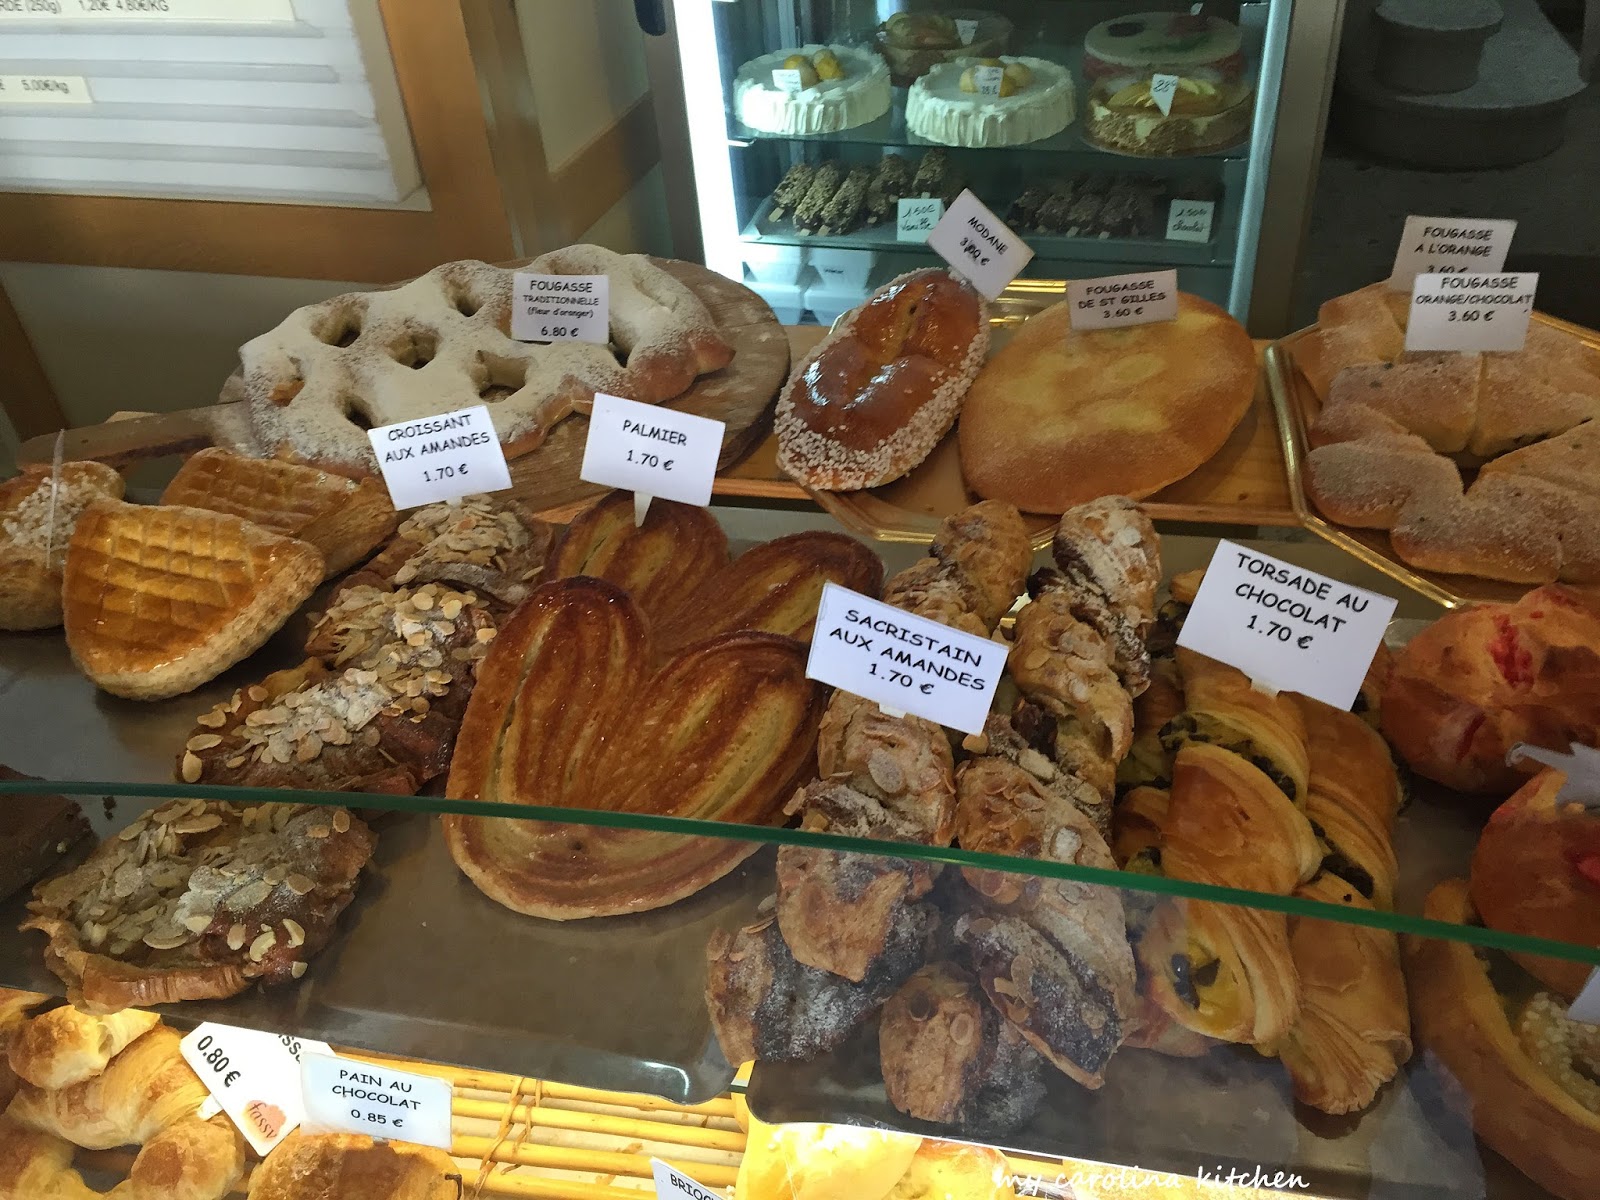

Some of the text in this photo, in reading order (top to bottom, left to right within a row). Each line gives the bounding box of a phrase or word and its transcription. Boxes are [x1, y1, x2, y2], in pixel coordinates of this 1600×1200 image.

[967, 216, 1009, 256] MODANE
[1423, 226, 1494, 240] FOUGASSE
[1414, 243, 1493, 257] A L'ORANGE
[530, 280, 593, 293] FOUGASSE
[1086, 280, 1156, 295] FOUGASSE
[1440, 276, 1519, 289] FOUGASSE
[523, 294, 600, 306] TRADITIONNELLE
[1078, 291, 1167, 309] DE ST GILLES
[1415, 293, 1534, 306] ORANGE/CHOCOLAT
[1103, 306, 1144, 319] 3.60 €
[1447, 310, 1495, 322] 3.60 €
[541, 326, 579, 337] 6.80 €
[388, 414, 472, 442] CROISSANT
[622, 419, 687, 446] PALMIER
[385, 431, 491, 463] AUX AMANDES
[626, 449, 674, 471] 1.70 €
[423, 463, 469, 482] 1.70 €
[1236, 552, 1369, 613] TORSADE AU
[1235, 583, 1347, 633] CHOCOLAT
[845, 609, 982, 667] SACRISTAIN
[1246, 614, 1314, 650] 1.70 €
[829, 627, 986, 691] AUX AMANDES
[868, 663, 935, 695] 1.70 €
[197, 1035, 242, 1088] 0.80 €
[339, 1069, 412, 1093] PAIN AU
[332, 1085, 421, 1111] CHOCOLAT
[350, 1108, 404, 1129] 0.85 €
[669, 1173, 715, 1200] BRIO
